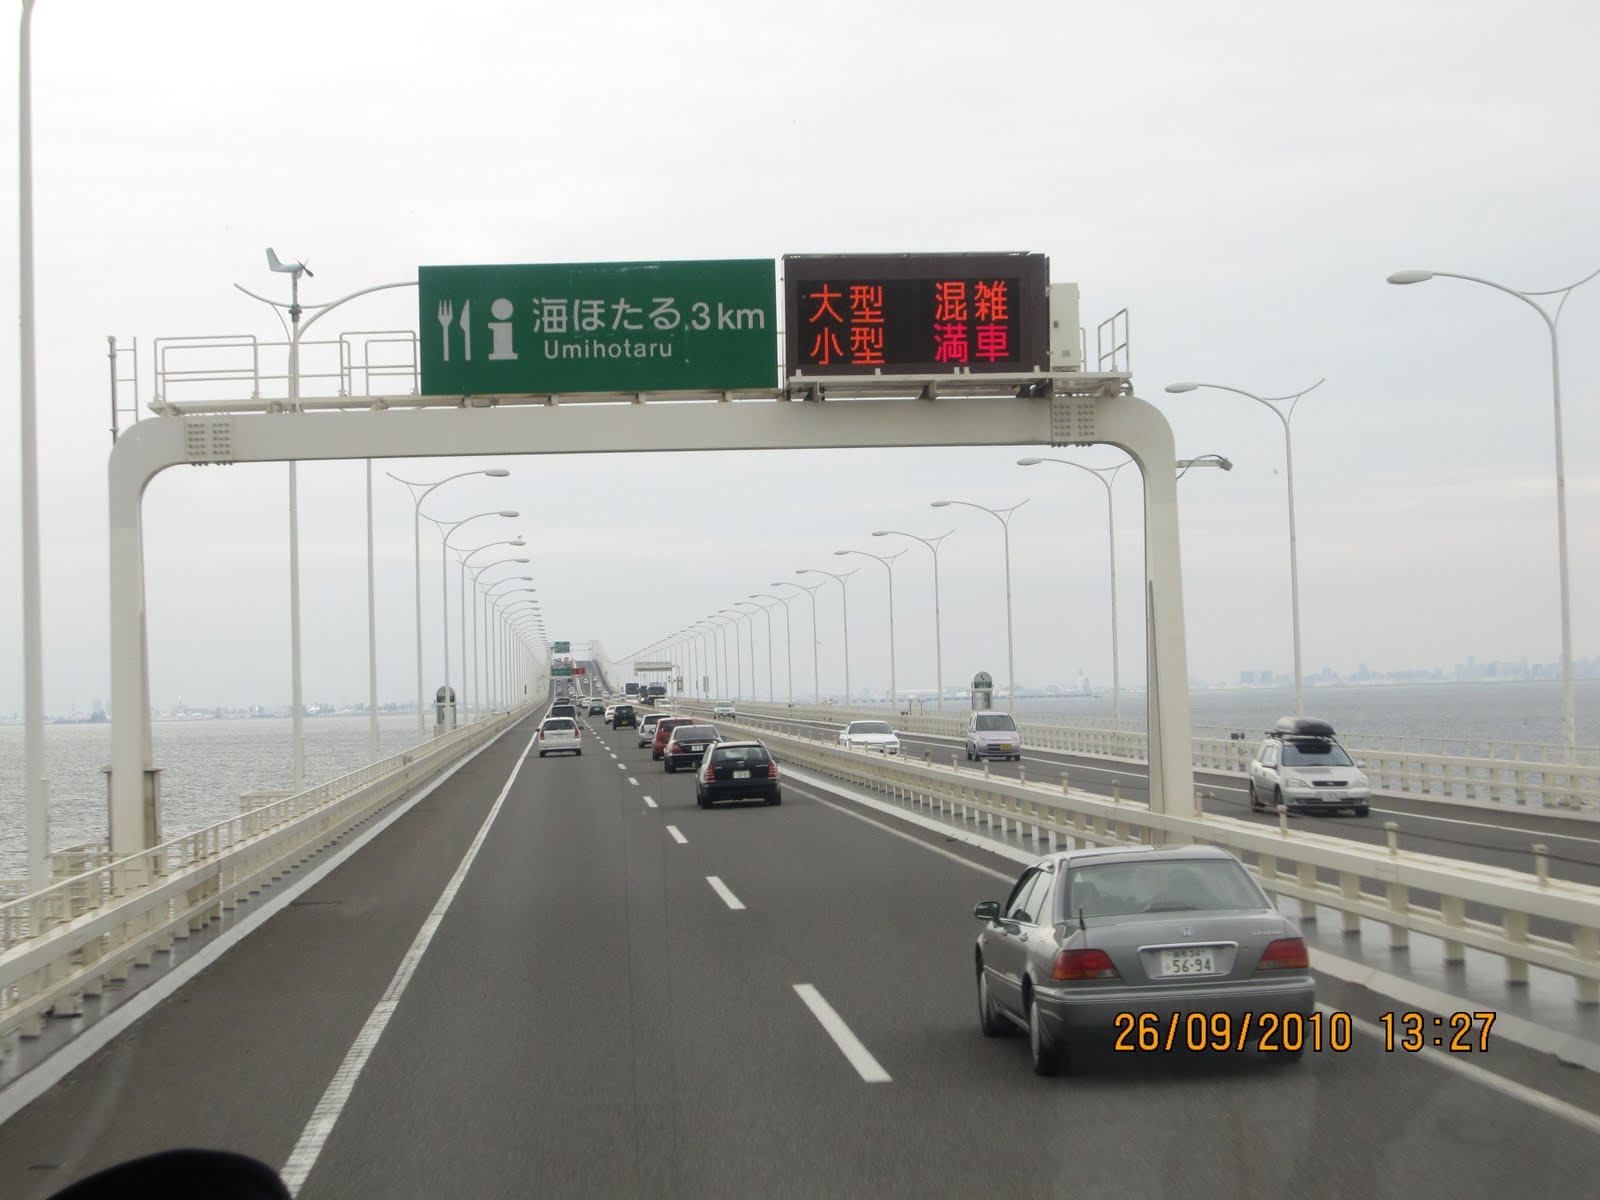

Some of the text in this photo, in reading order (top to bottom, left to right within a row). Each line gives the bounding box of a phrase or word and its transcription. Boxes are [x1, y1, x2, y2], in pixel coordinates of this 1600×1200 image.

[532, 297, 681, 333] 海ほたる
[809, 280, 1009, 323] 大型 混雑
[543, 338, 673, 359] Umihotaru
[809, 322, 1009, 364] 小型 満車
